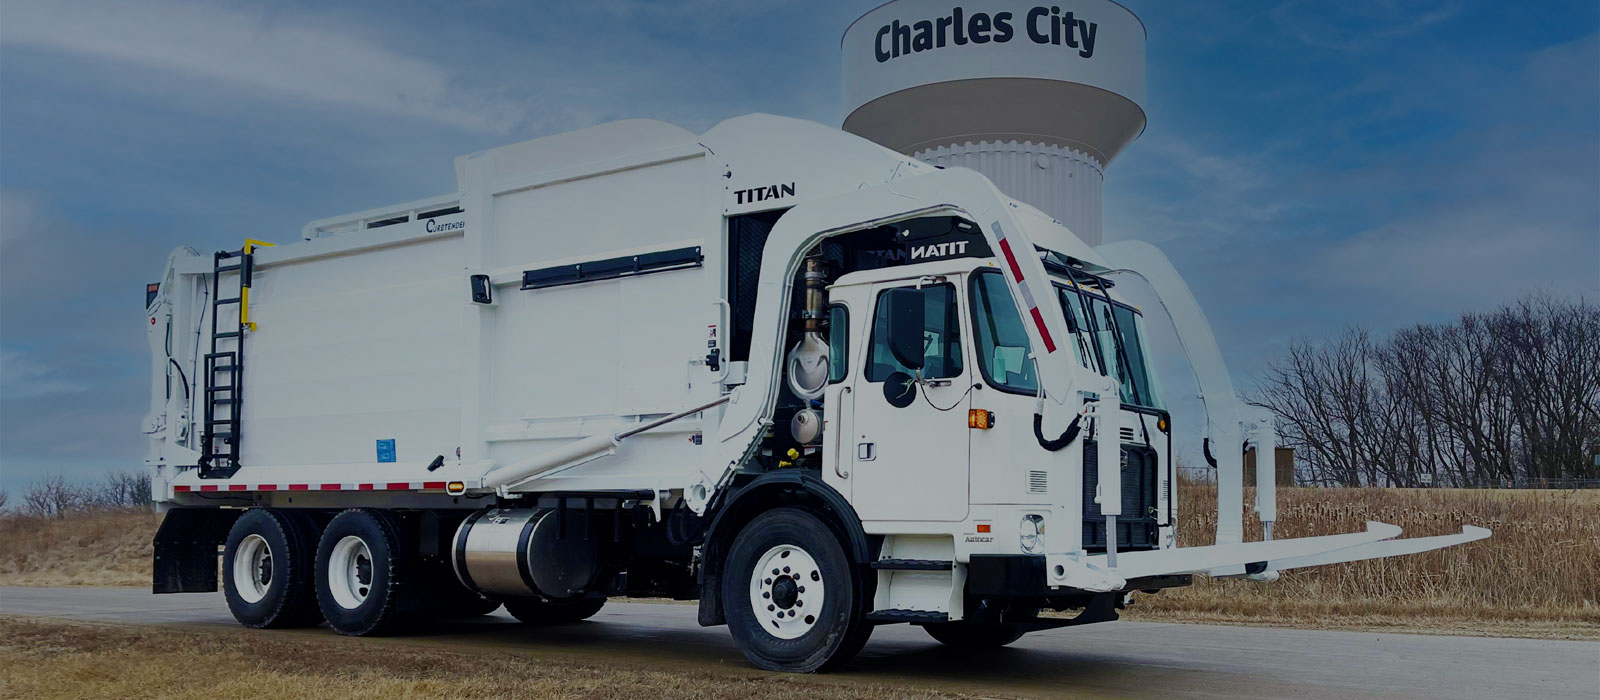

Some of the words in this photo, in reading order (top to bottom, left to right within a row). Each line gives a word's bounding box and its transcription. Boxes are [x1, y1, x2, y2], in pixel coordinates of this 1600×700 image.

[874, 6, 1014, 63] Charles
[1026, 5, 1098, 58] City
[733, 182, 795, 204] TITAN
